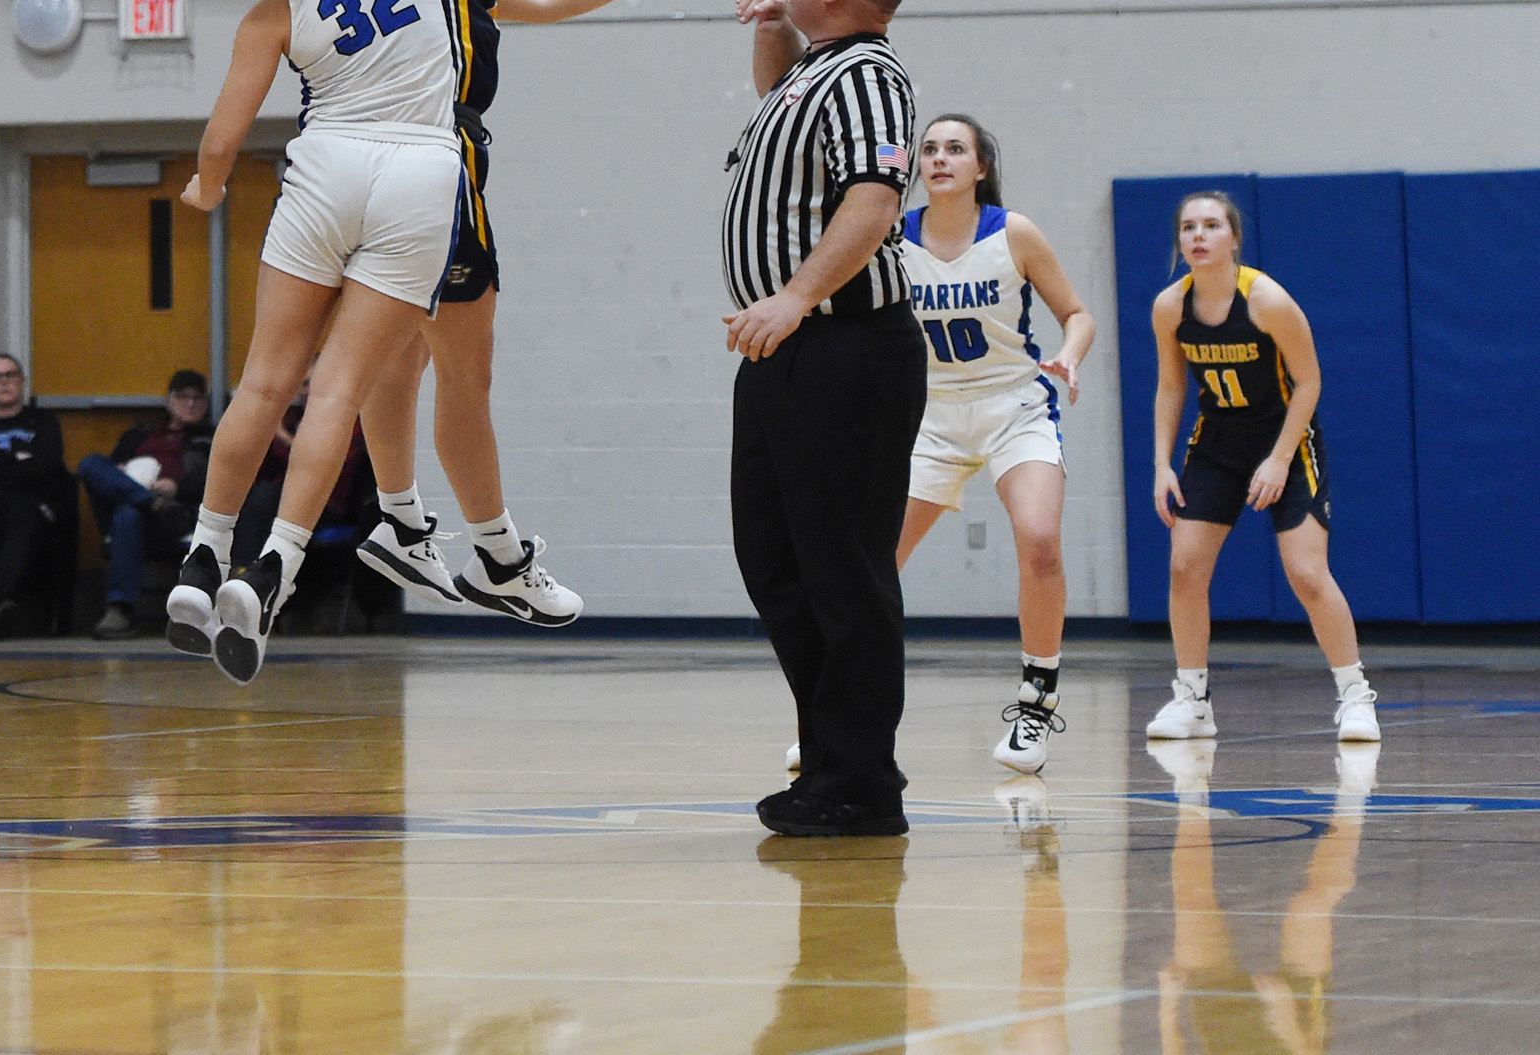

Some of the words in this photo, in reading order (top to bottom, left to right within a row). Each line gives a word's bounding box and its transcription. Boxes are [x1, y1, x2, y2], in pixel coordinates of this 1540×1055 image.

[911, 280, 1000, 310] PARTANS
[923, 318, 989, 363] 10
[1204, 369, 1249, 407] 11
